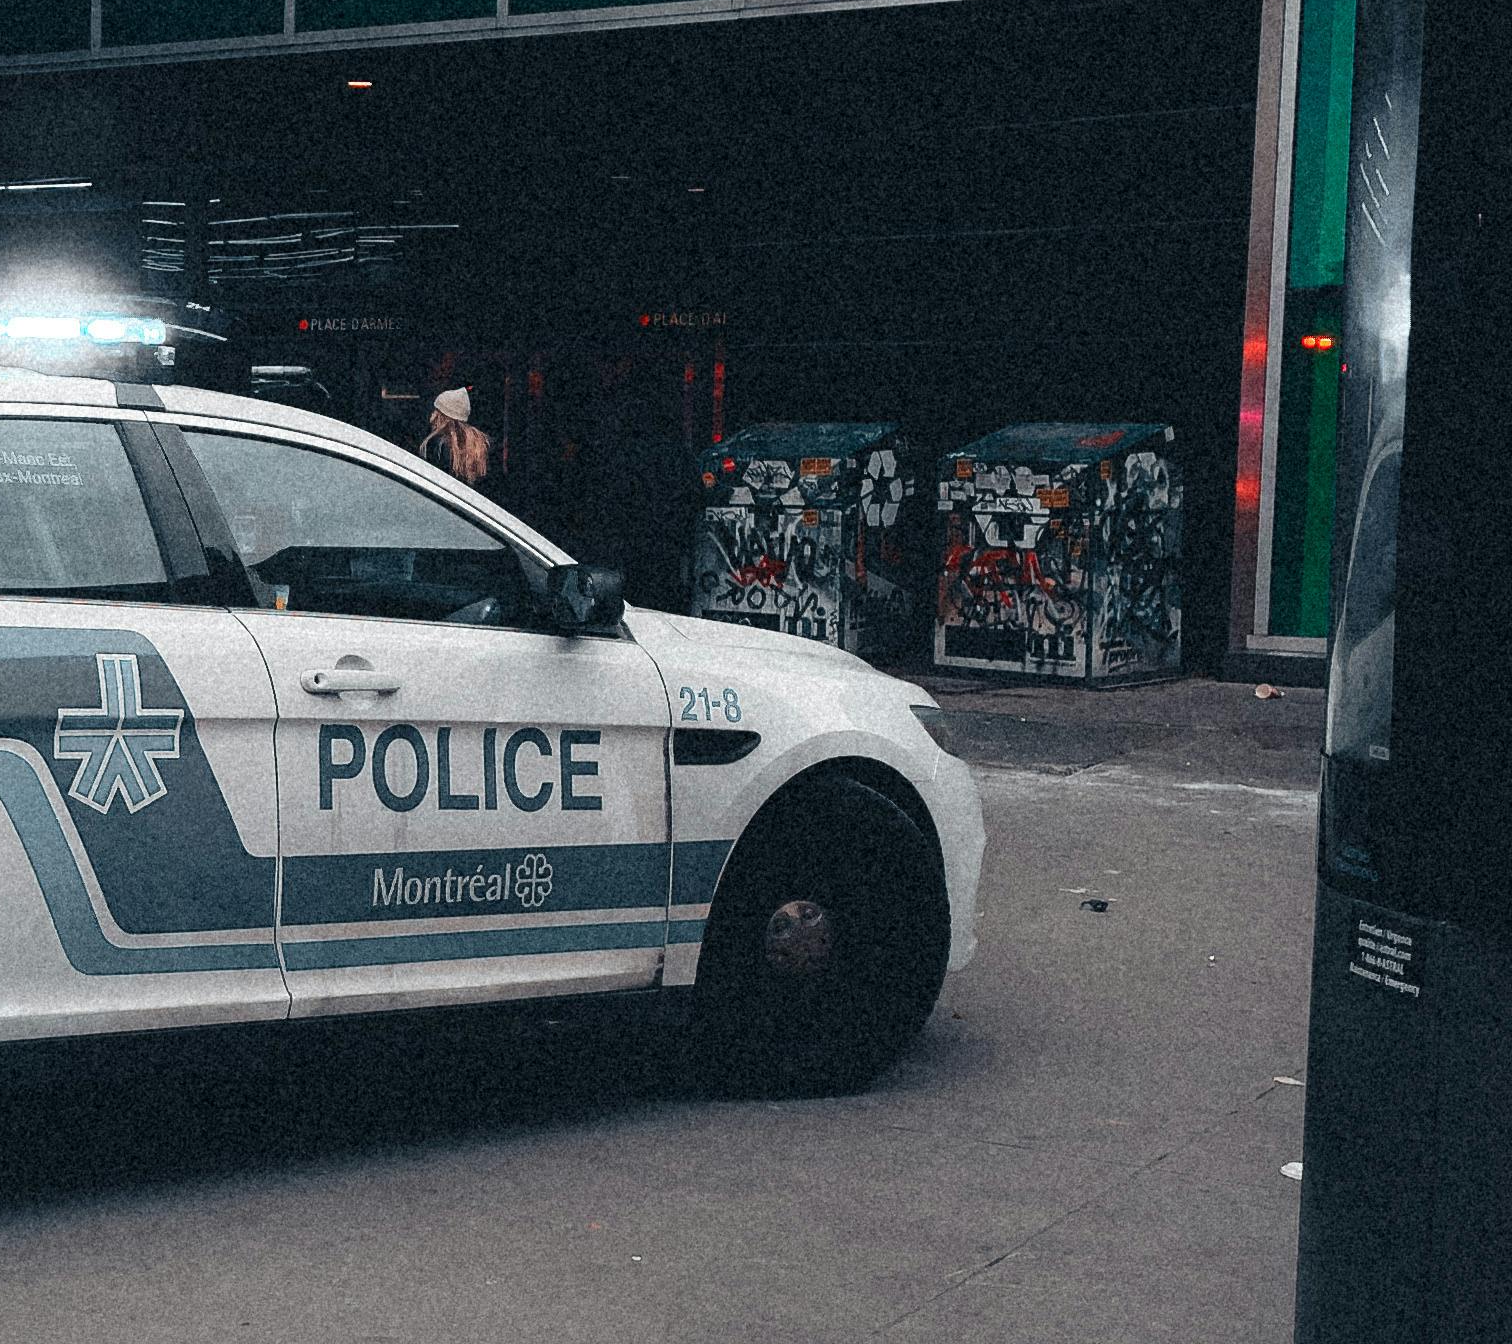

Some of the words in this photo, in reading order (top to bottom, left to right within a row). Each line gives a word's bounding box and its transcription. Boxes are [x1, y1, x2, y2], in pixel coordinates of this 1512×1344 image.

[311, 318, 346, 331] PLACE
[654, 313, 695, 327] PLACE
[678, 686, 742, 723] 21-8
[319, 723, 603, 813] POLICE
[372, 862, 511, 907] Montréal
